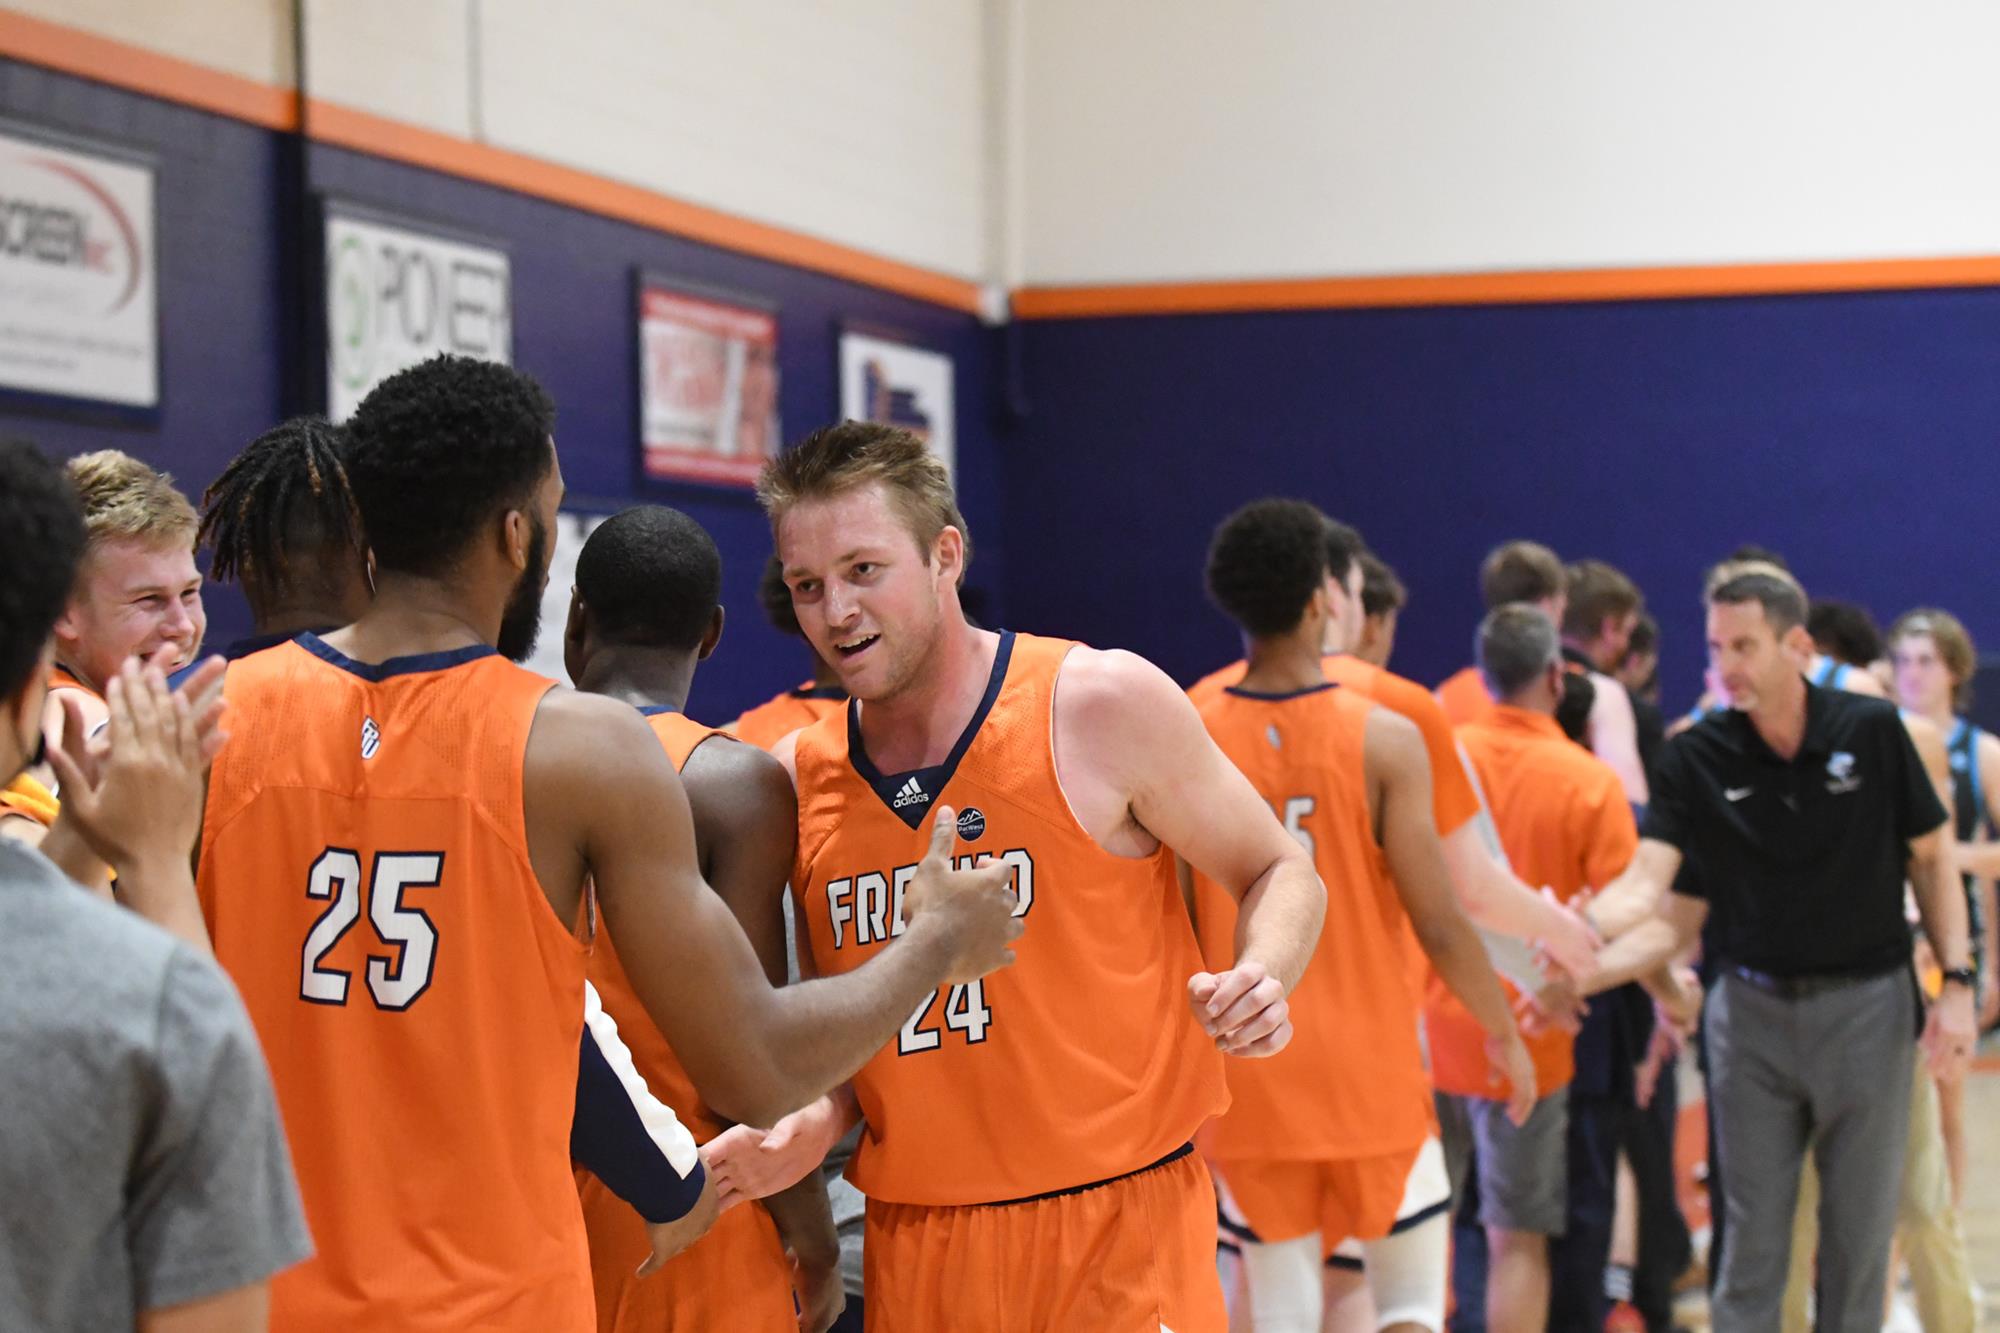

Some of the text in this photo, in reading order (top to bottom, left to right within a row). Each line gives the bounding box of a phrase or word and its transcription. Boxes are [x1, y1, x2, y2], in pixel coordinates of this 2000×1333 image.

[893, 793, 929, 808] adidas
[958, 823, 984, 832] PacWest
[300, 845, 446, 1012] 25
[827, 848, 1034, 949] FREO
[898, 978, 992, 1056] 24
